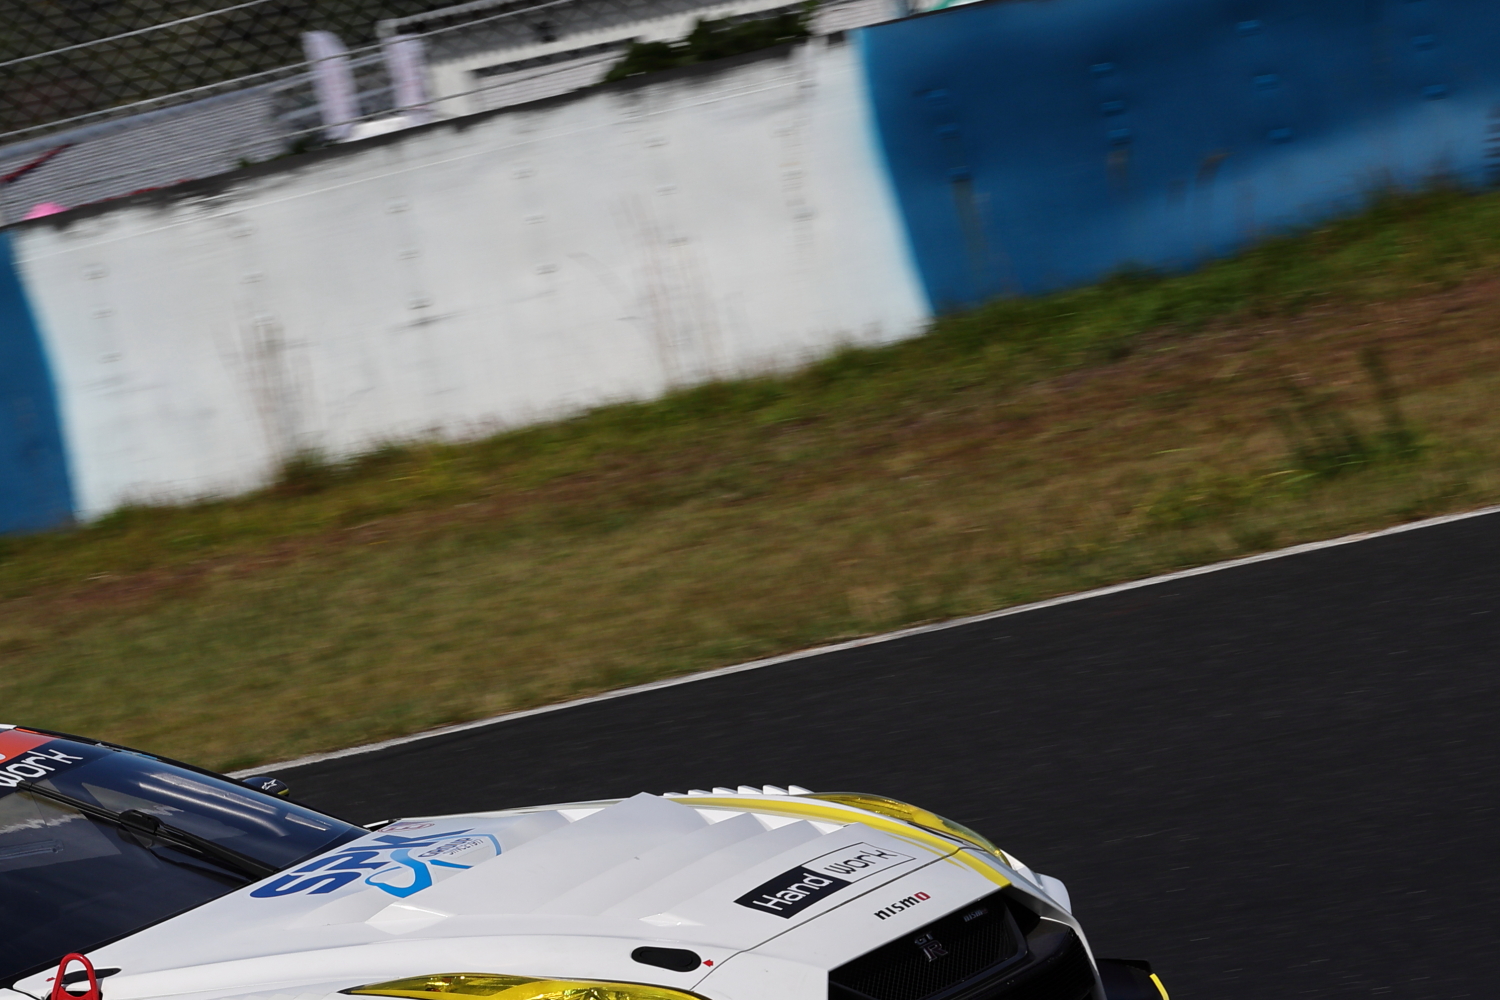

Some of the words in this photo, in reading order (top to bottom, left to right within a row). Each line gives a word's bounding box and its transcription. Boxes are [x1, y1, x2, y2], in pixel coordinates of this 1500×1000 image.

[752, 873, 833, 911] Hand
[824, 849, 898, 875] work
[874, 891, 931, 921] nismo
